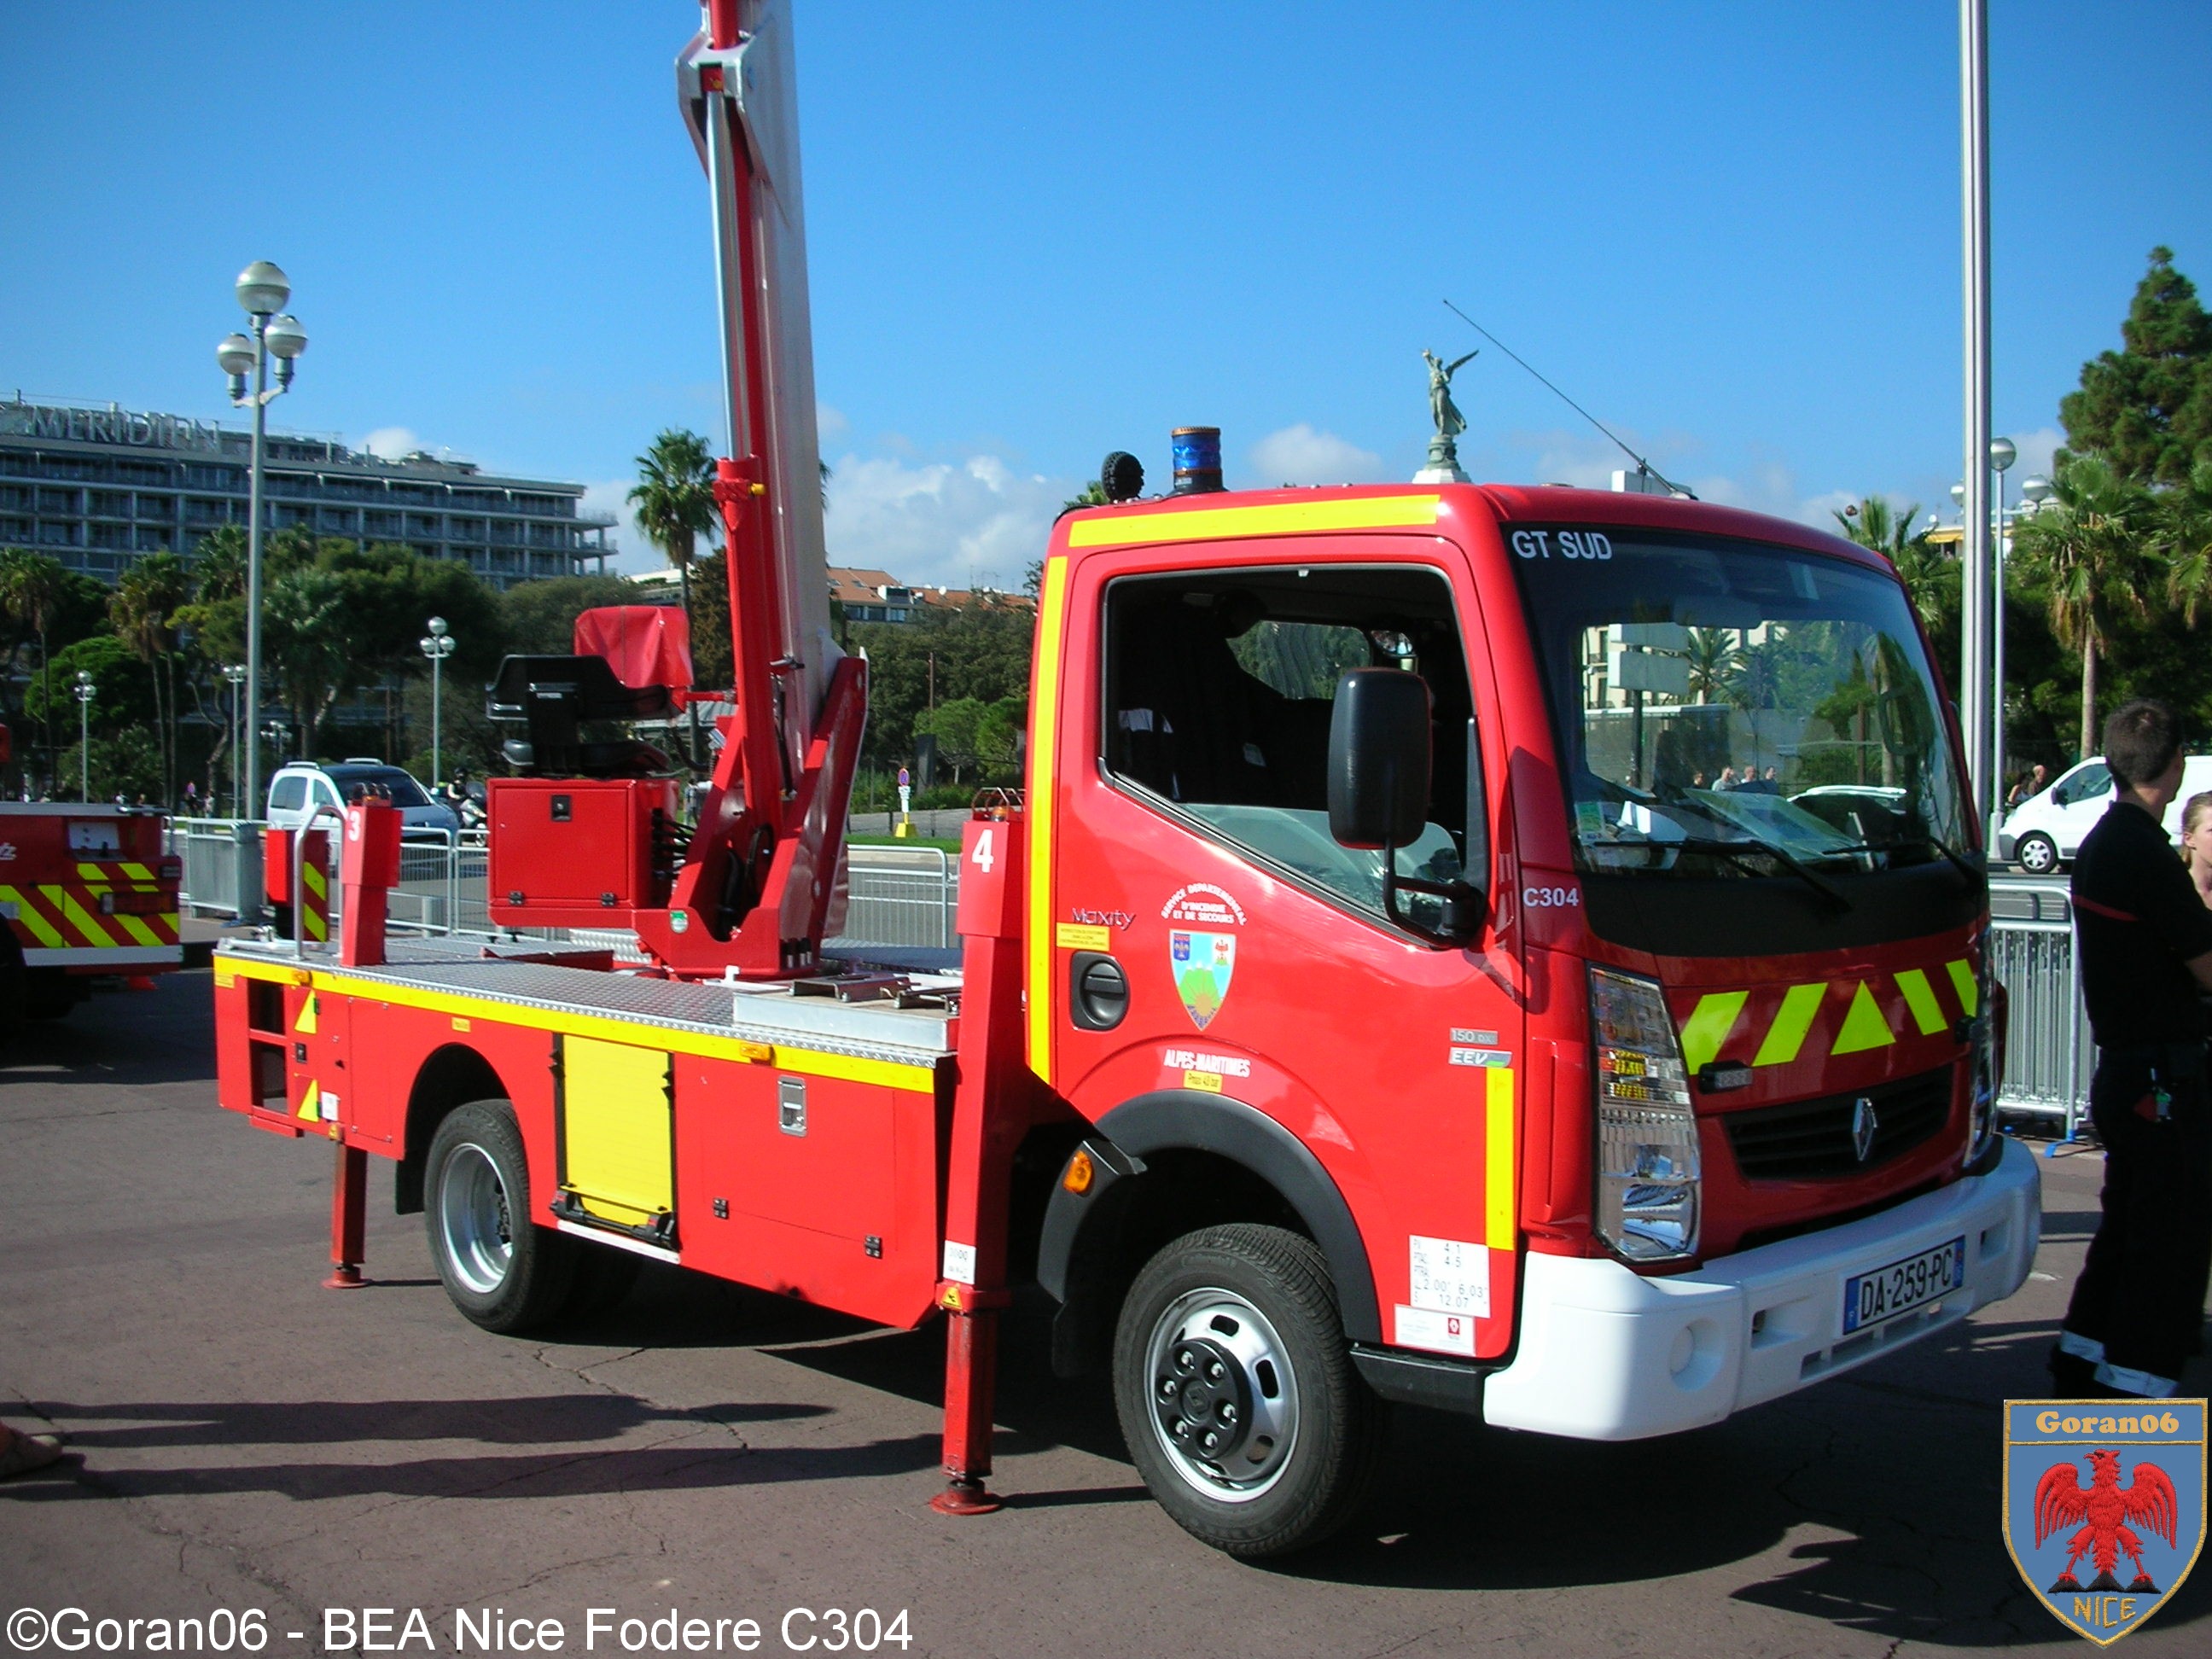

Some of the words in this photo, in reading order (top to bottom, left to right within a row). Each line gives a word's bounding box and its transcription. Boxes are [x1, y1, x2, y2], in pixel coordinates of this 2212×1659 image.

[1511, 530, 1550, 559] GT
[1557, 531, 1613, 560] SUD
[348, 810, 361, 841] 3
[971, 829, 994, 874] 4
[1522, 887, 1580, 907] C304
[1072, 907, 1137, 931] Maxity
[1197, 911, 1235, 924] SECOURS
[1452, 1029, 1475, 1042] 150
[1163, 1049, 1252, 1079] ALPES-MARITIMES
[1452, 1050, 1488, 1065] EEV
[1860, 1248, 1953, 1321] DA-259-PC
